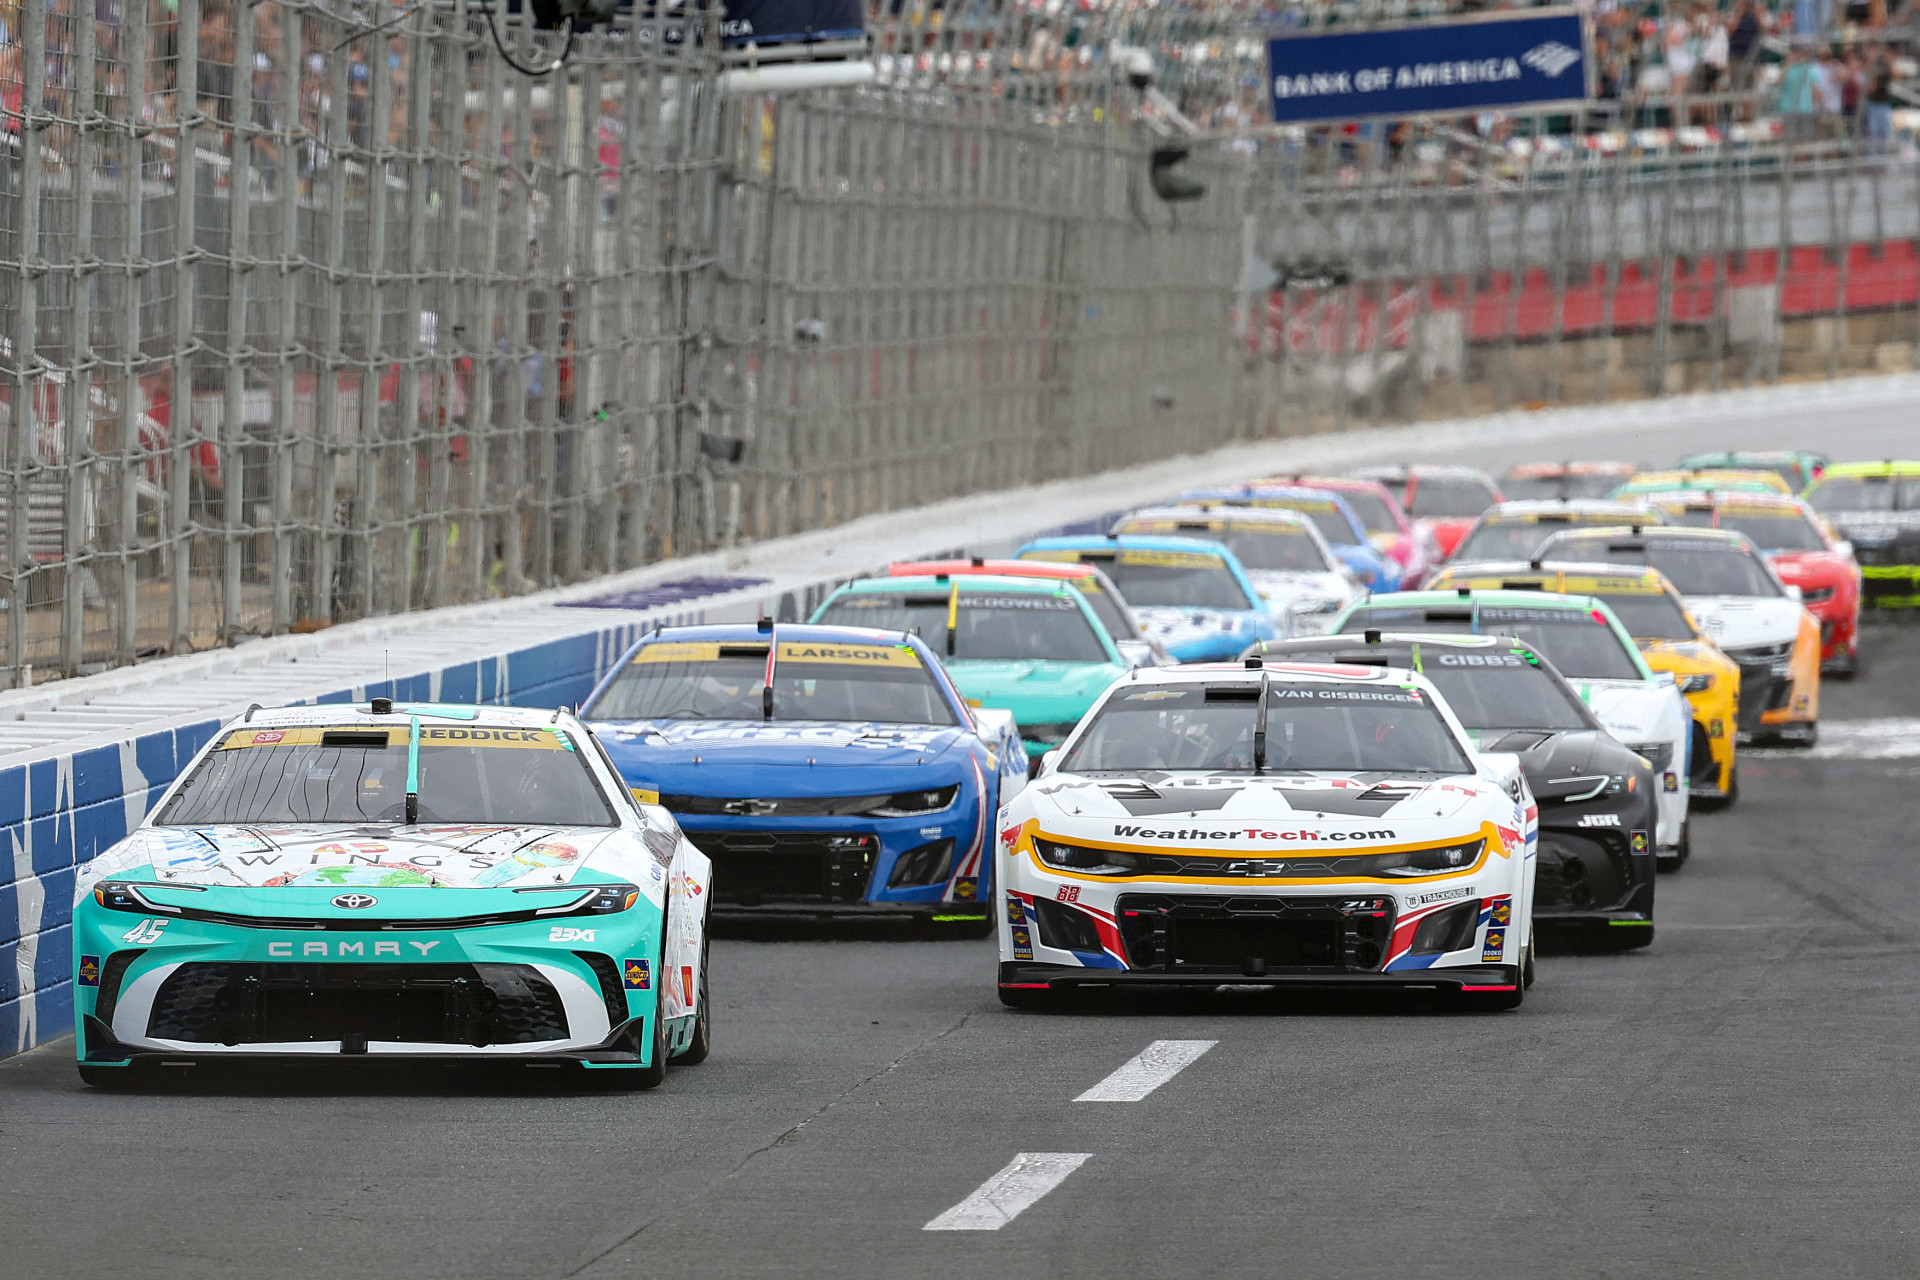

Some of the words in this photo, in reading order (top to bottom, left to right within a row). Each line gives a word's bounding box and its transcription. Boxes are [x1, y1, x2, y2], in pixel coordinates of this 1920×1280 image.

[1275, 73, 1351, 98] BANK
[1354, 68, 1392, 92] OF
[1396, 57, 1522, 89] AMERICA
[787, 648, 890, 660] LARSON
[1439, 654, 1522, 667] GIBBS
[1274, 689, 1314, 699] VAN
[1577, 814, 1621, 827] JGR
[236, 854, 495, 870] WINGS
[1056, 884, 1082, 903] 88
[1422, 888, 1468, 902] TRACKHOUSE
[1341, 899, 1384, 910] ZL1
[121, 918, 170, 944] 45
[548, 926, 600, 942] 23XI
[268, 941, 441, 956] CAMRY
[625, 970, 649, 981] SUNOCO
